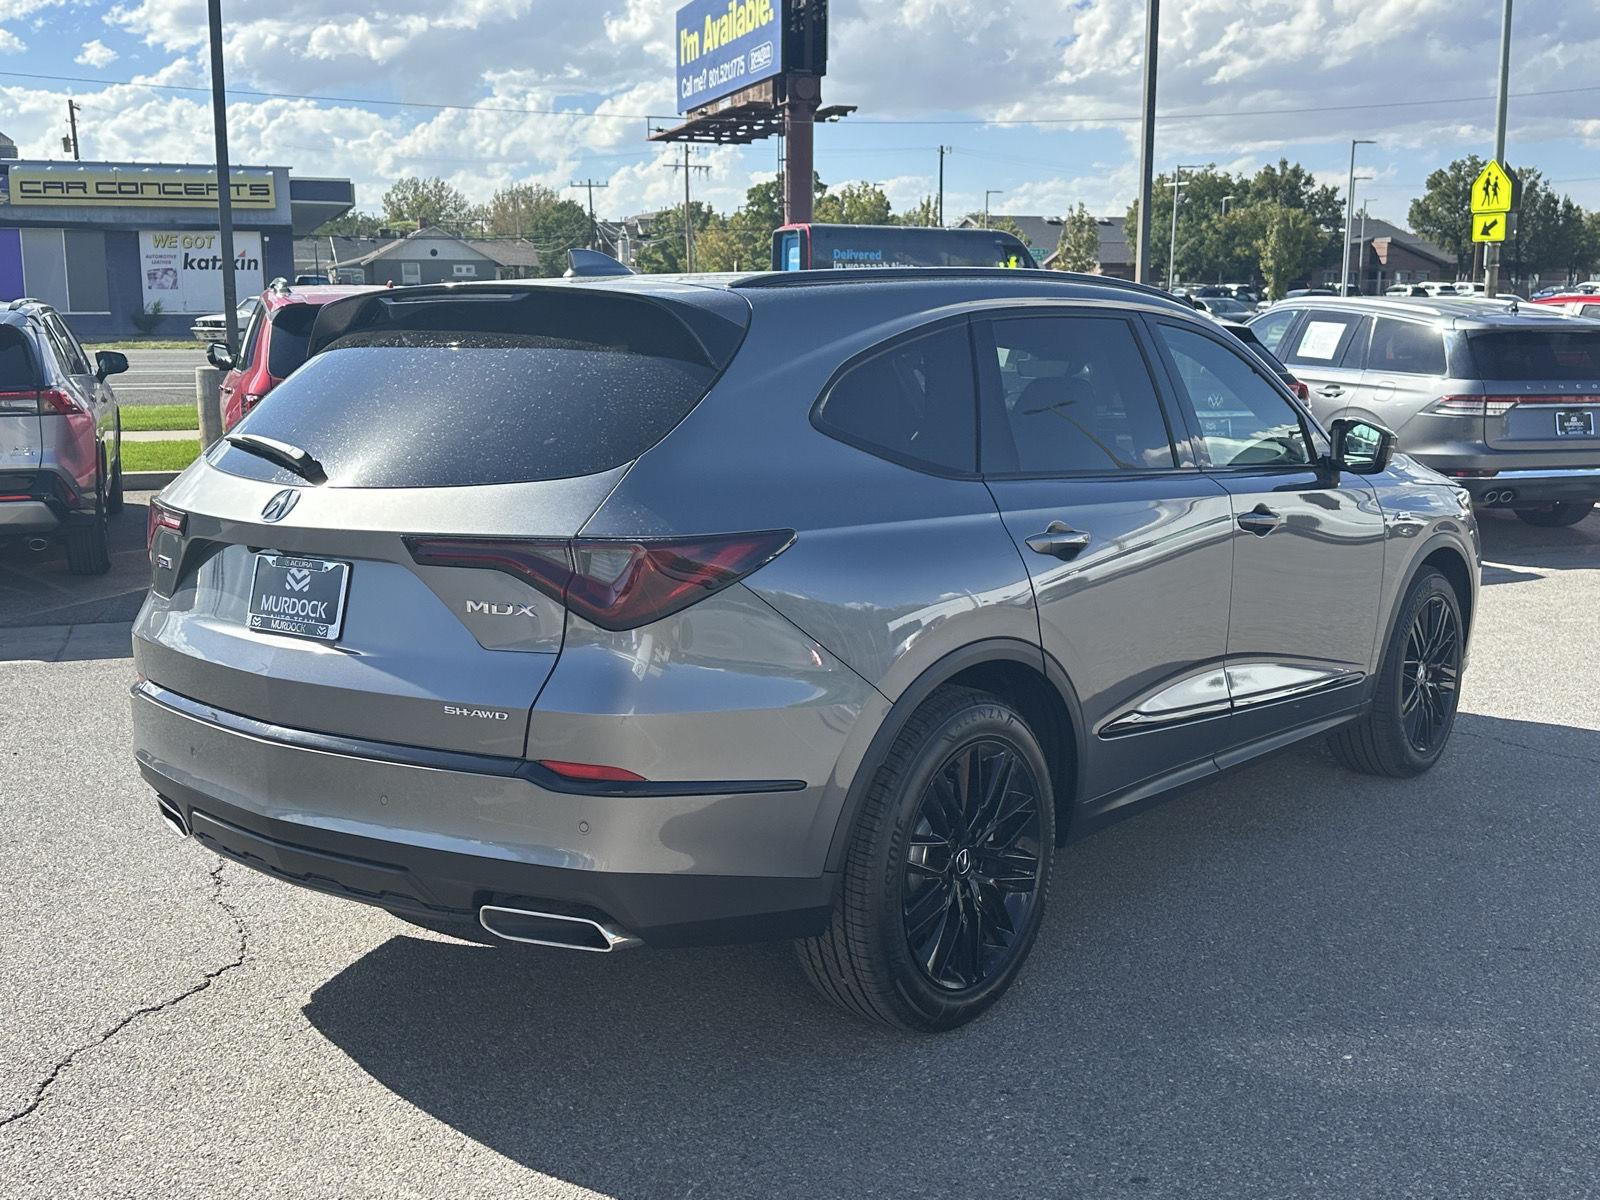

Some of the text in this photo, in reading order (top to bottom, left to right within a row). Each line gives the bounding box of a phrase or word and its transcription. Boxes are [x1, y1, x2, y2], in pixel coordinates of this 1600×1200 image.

[681, 0, 774, 66] I'm Available.
[681, 75, 693, 98] Call
[693, 68, 707, 93] me?
[20, 181, 87, 194] CAR
[153, 234, 216, 249] WE GOT
[832, 249, 882, 260] Delivered
[290, 560, 313, 568] ACURA
[260, 594, 328, 619] MURDOCK
[466, 600, 538, 618] MDX
[270, 620, 306, 633] MURDOCK
